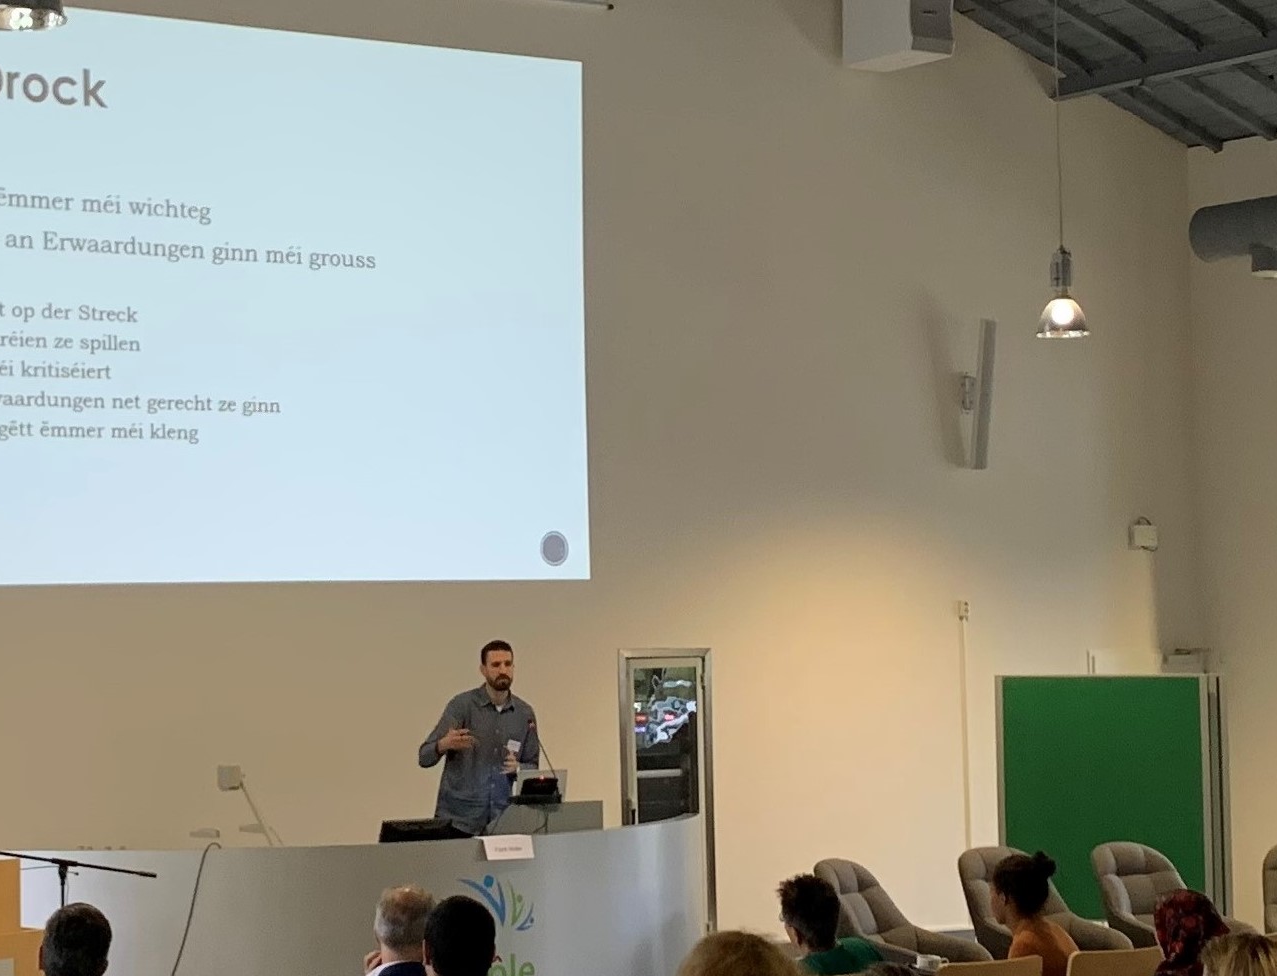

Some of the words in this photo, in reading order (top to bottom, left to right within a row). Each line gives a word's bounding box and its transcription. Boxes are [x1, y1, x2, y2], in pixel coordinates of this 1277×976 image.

[81, 194, 122, 214] méi
[128, 198, 212, 225] wichteg
[5, 235, 34, 249] an
[43, 231, 205, 262] Erwaardungen
[212, 242, 258, 265] ginn
[265, 246, 302, 265] méi
[309, 251, 376, 270] grouss
[11, 304, 35, 322] op
[41, 303, 72, 320] der
[78, 304, 138, 323] Streck
[54, 335, 73, 349] ze
[80, 333, 141, 355] spillen
[21, 360, 111, 380] kritiséiert
[112, 395, 141, 410] net
[147, 394, 213, 415] gerecht
[218, 398, 237, 413] ze
[242, 396, 281, 417] ginn
[111, 422, 144, 439] méi
[150, 422, 199, 445] kleng
